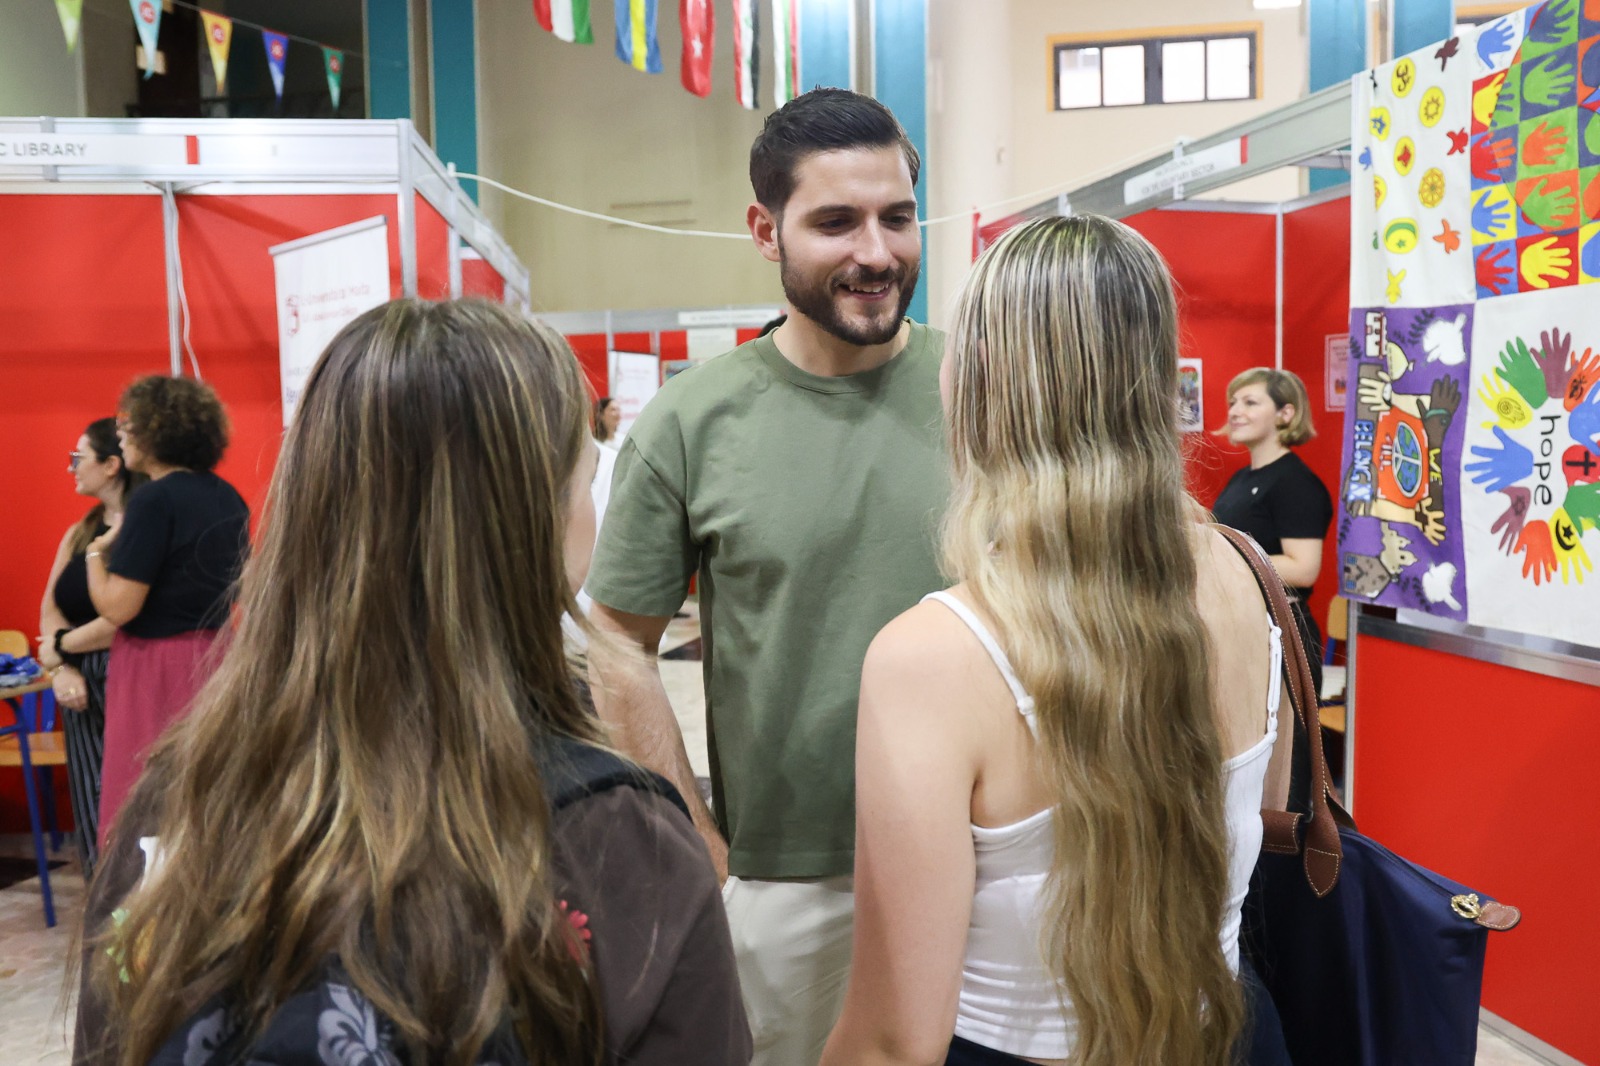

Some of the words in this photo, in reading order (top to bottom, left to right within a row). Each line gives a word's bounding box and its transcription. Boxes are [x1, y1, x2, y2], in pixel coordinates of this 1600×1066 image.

[12, 142, 87, 157] LIBRARY
[1351, 419, 1375, 482] BELONG
[1429, 447, 1443, 486] WE
[1533, 415, 1562, 506] hope
